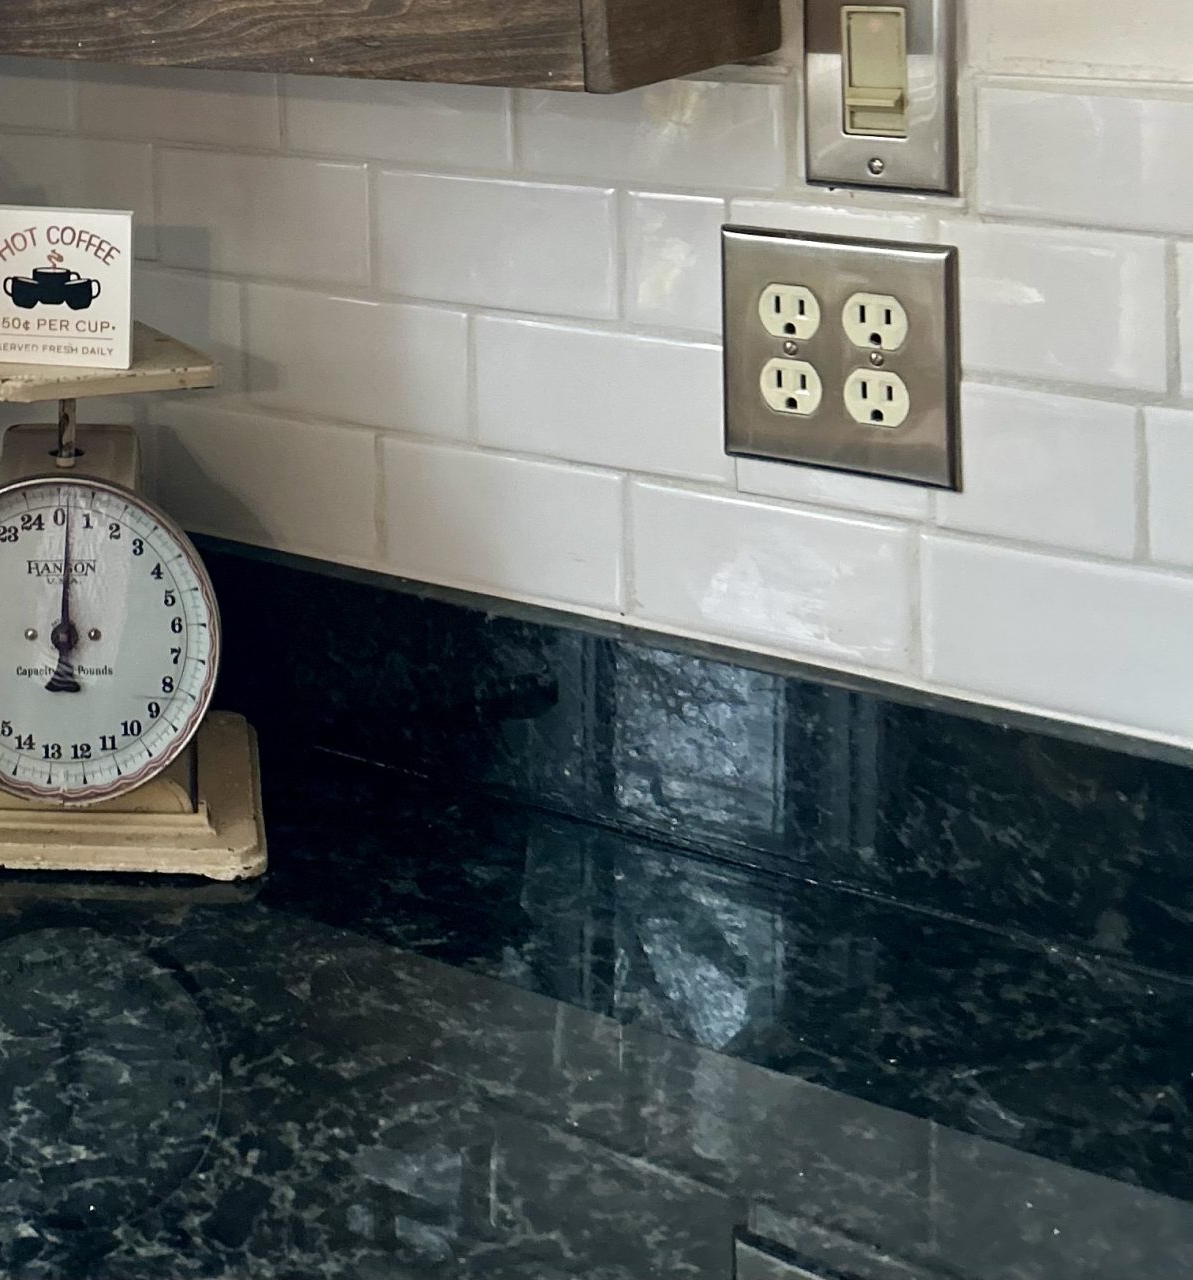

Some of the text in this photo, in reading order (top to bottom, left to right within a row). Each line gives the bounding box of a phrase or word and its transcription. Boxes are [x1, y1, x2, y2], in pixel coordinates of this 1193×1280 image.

[46, 225, 121, 266] COFFEE
[37, 319, 70, 331] PER
[42, 344, 78, 355] FRESH
[82, 346, 114, 356] DAILY
[21, 513, 45, 531] 24
[53, 508, 65, 526] 0
[82, 514, 93, 529] 1
[109, 524, 121, 539] 2
[132, 539, 144, 555] 3
[151, 563, 163, 579] 4
[164, 590, 176, 606] 5
[171, 617, 182, 633] 6
[171, 647, 182, 663] 7
[77, 664, 113, 676] Pounds
[162, 676, 174, 692] 8
[148, 702, 160, 718] 9
[121, 720, 141, 737] 10
[15, 735, 35, 750] 14
[100, 735, 117, 750] 11
[42, 744, 63, 759] 13
[71, 744, 92, 759] 12
